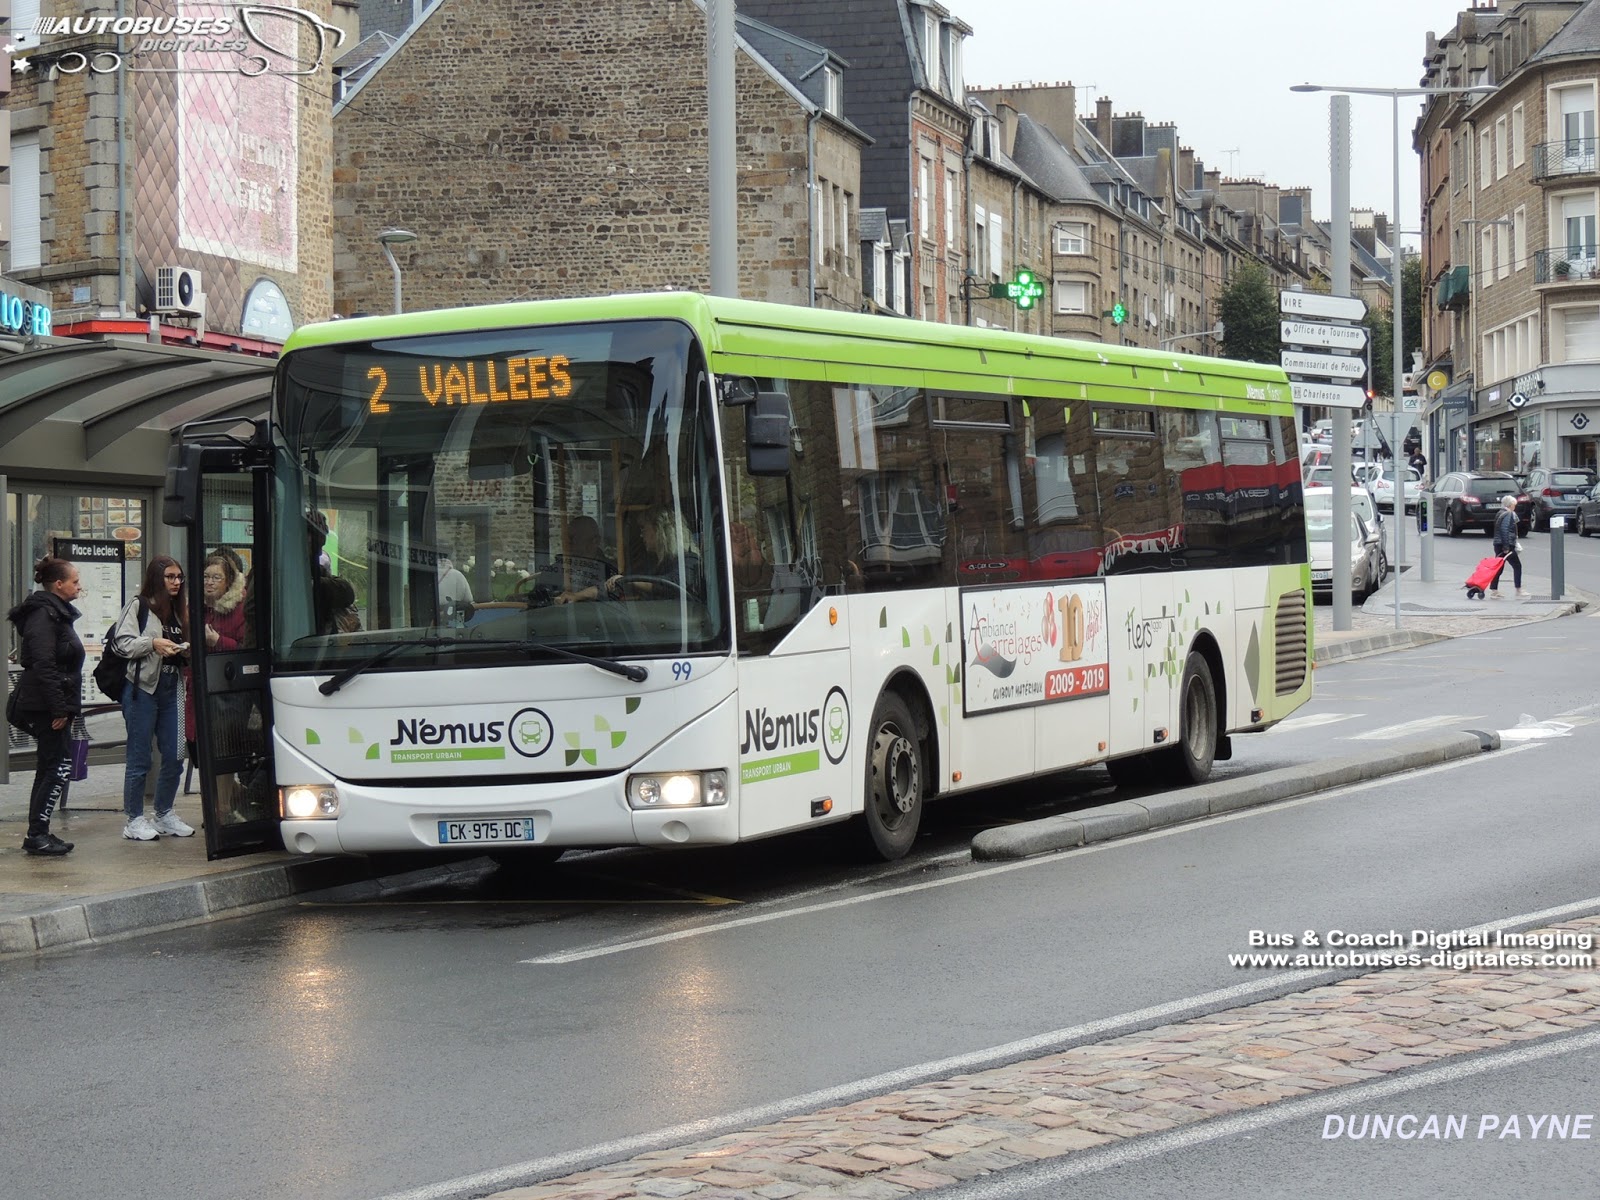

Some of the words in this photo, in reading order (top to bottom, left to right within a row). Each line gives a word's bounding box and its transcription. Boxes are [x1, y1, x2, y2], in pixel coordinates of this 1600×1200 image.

[1284, 297, 1302, 308] VIRE
[1293, 324, 1315, 335] Office
[1318, 327, 1326, 336] de
[1330, 327, 1360, 339] Tourisme
[1284, 357, 1329, 370] Commissariat
[1330, 361, 1339, 371] de
[1341, 362, 1361, 373] Police
[367, 367, 390, 413] 2
[419, 355, 572, 406] VALLEES
[1303, 388, 1341, 400] Charleston
[72, 544, 92, 556] Place
[93, 545, 119, 557] Leclerc
[967, 602, 1015, 645] Ambiance
[1058, 593, 1085, 662] 10
[974, 617, 1043, 667] Carrelages
[671, 661, 692, 681] 99
[1049, 672, 1075, 695] 2009
[1081, 667, 1105, 691] 2019
[742, 765, 772, 779] TRANSPORT
[773, 761, 791, 774] URBAIN
